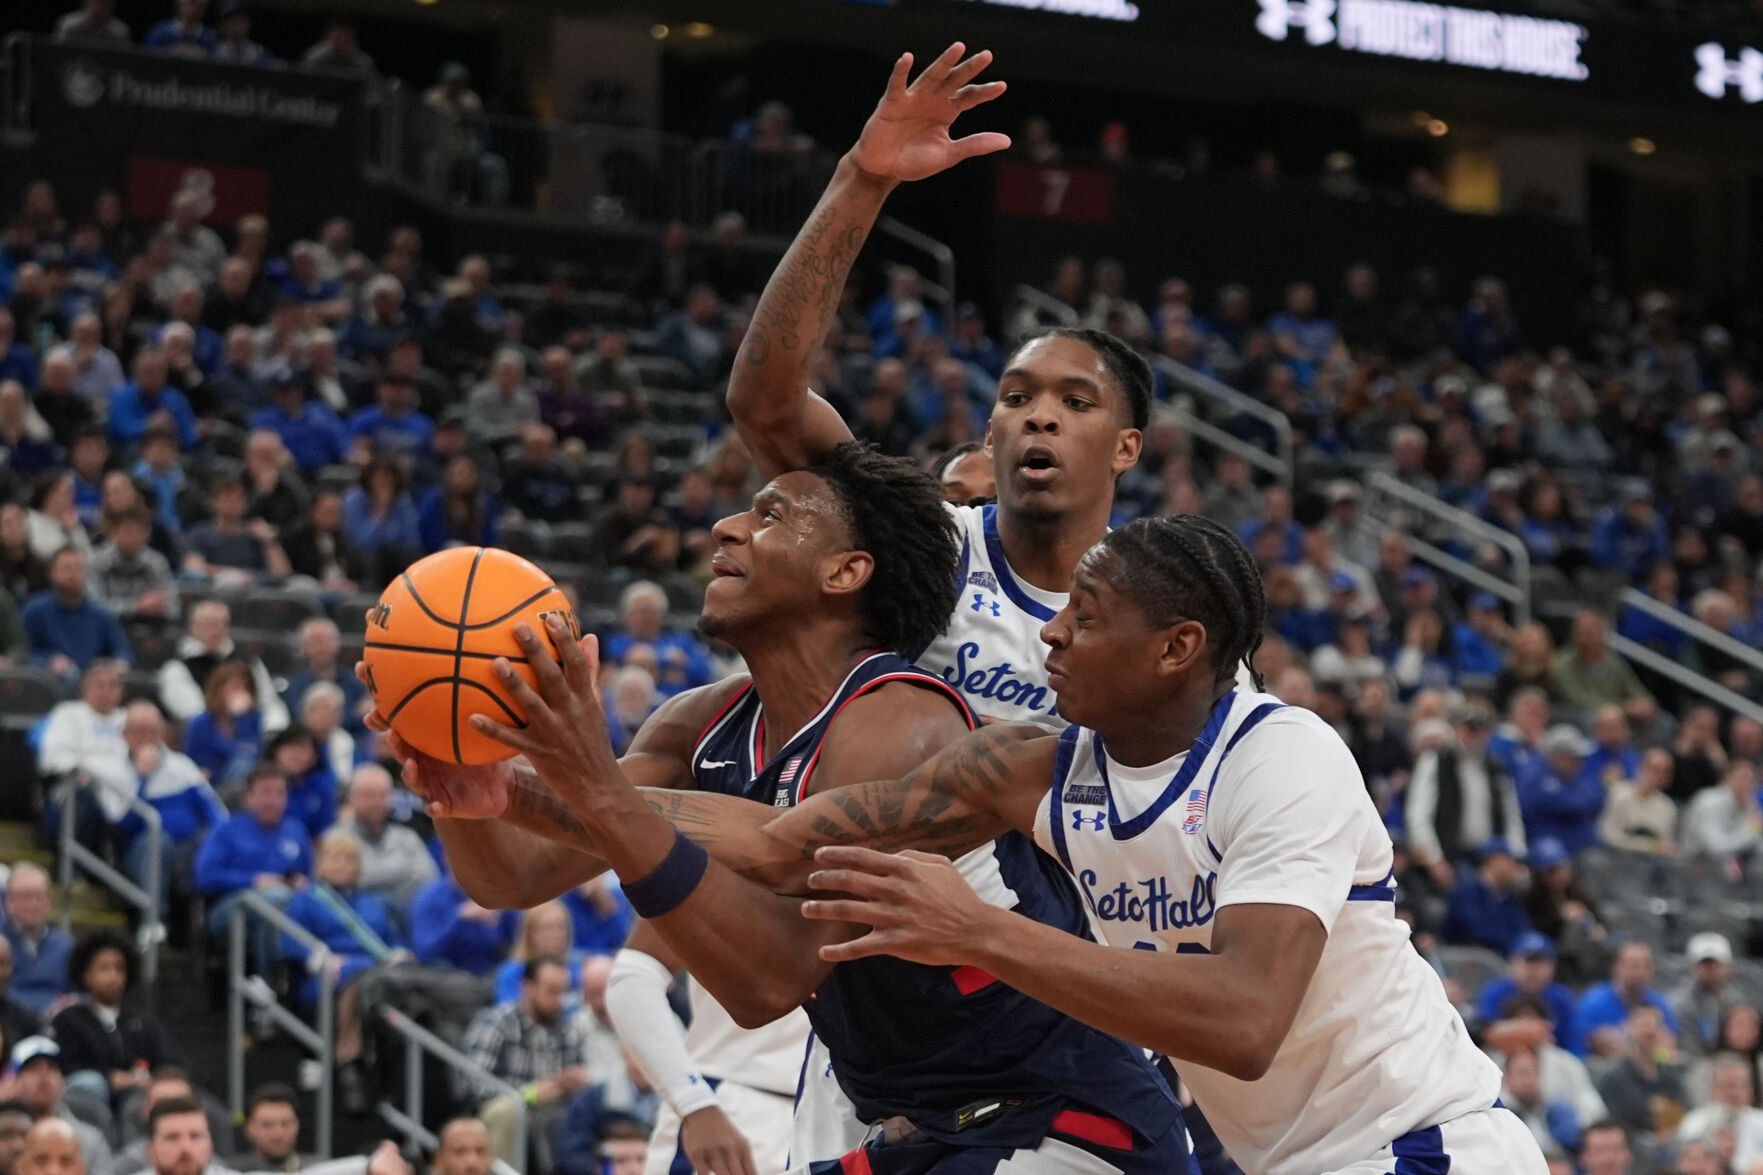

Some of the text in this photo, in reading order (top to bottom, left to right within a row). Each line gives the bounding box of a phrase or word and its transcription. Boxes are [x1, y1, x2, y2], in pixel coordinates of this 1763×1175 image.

[1338, 0, 1444, 61] PROTECT
[1446, 6, 1500, 69] THIS
[109, 71, 340, 127] Prudential Center
[1041, 168, 1071, 216] 7
[943, 642, 1047, 710] Seton
[1063, 792, 1106, 806] CHANGE
[1070, 784, 1106, 795] BE THE
[1079, 869, 1218, 932] Seto Hall
